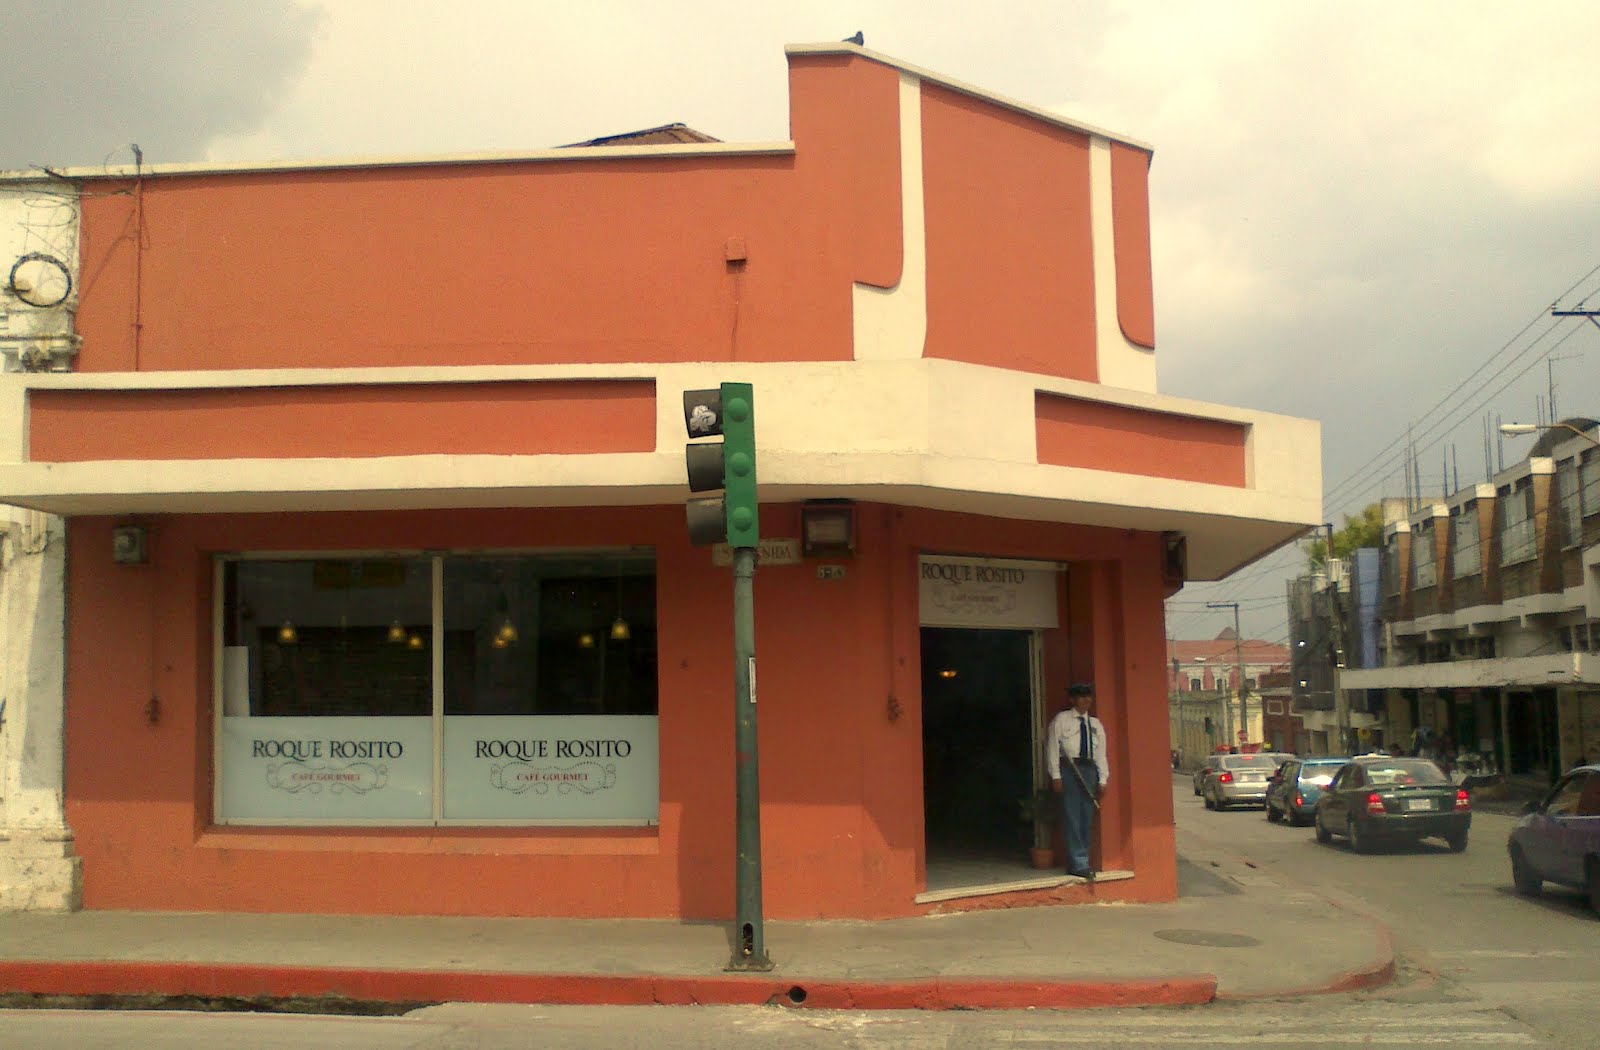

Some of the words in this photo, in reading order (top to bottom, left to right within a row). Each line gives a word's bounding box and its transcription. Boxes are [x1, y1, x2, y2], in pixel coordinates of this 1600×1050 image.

[922, 562, 970, 584] ROQUE
[976, 565, 1024, 584] ROSITO
[252, 740, 322, 762] ROQUE
[329, 740, 403, 759] ROSITO
[475, 740, 548, 762] ROQUE
[556, 740, 631, 758] ROSITO
[316, 773, 361, 782] GOURMET
[542, 773, 589, 782] GOURMET
